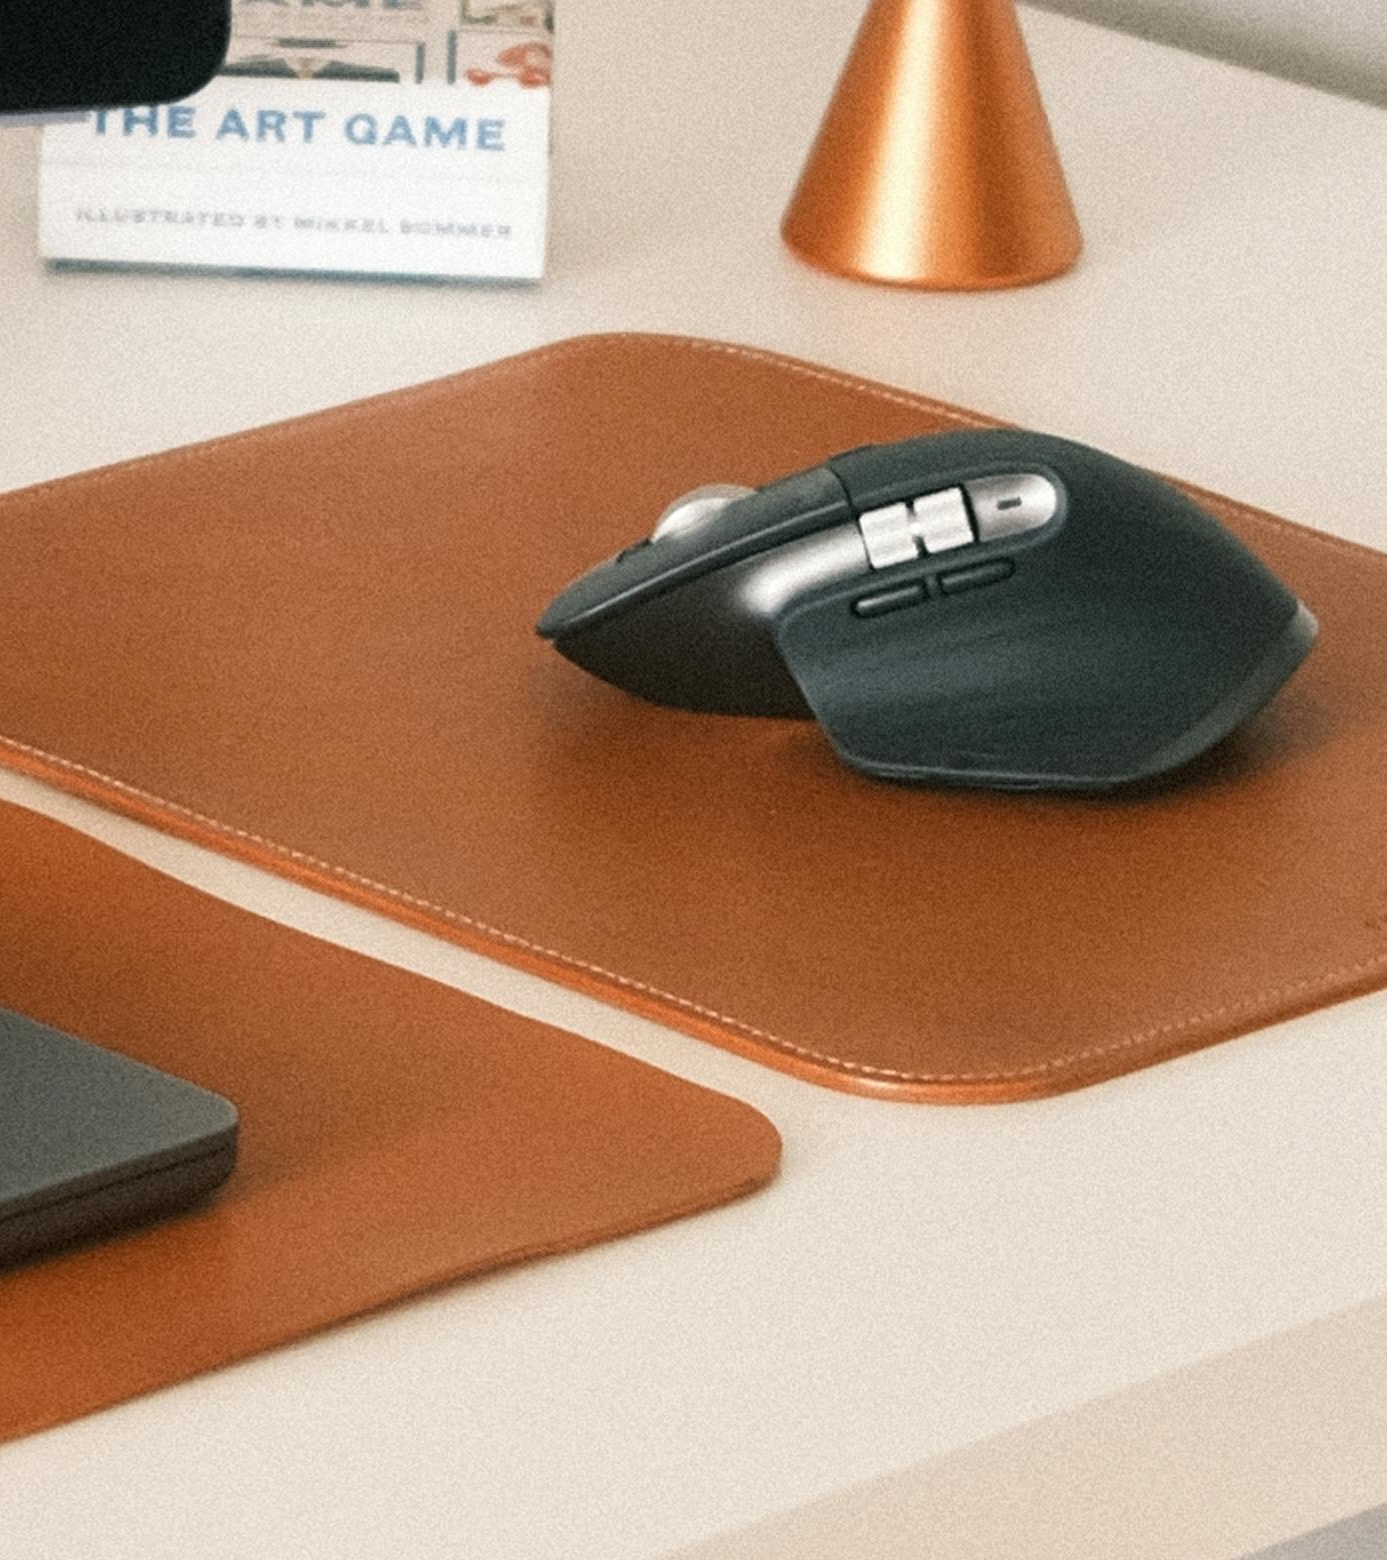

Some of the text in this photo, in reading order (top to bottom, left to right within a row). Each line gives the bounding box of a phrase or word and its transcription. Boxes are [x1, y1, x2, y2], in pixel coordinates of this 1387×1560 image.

[216, 108, 326, 144] ART
[344, 113, 507, 151] GAME
[74, 207, 245, 228] ILLUSTRATED
